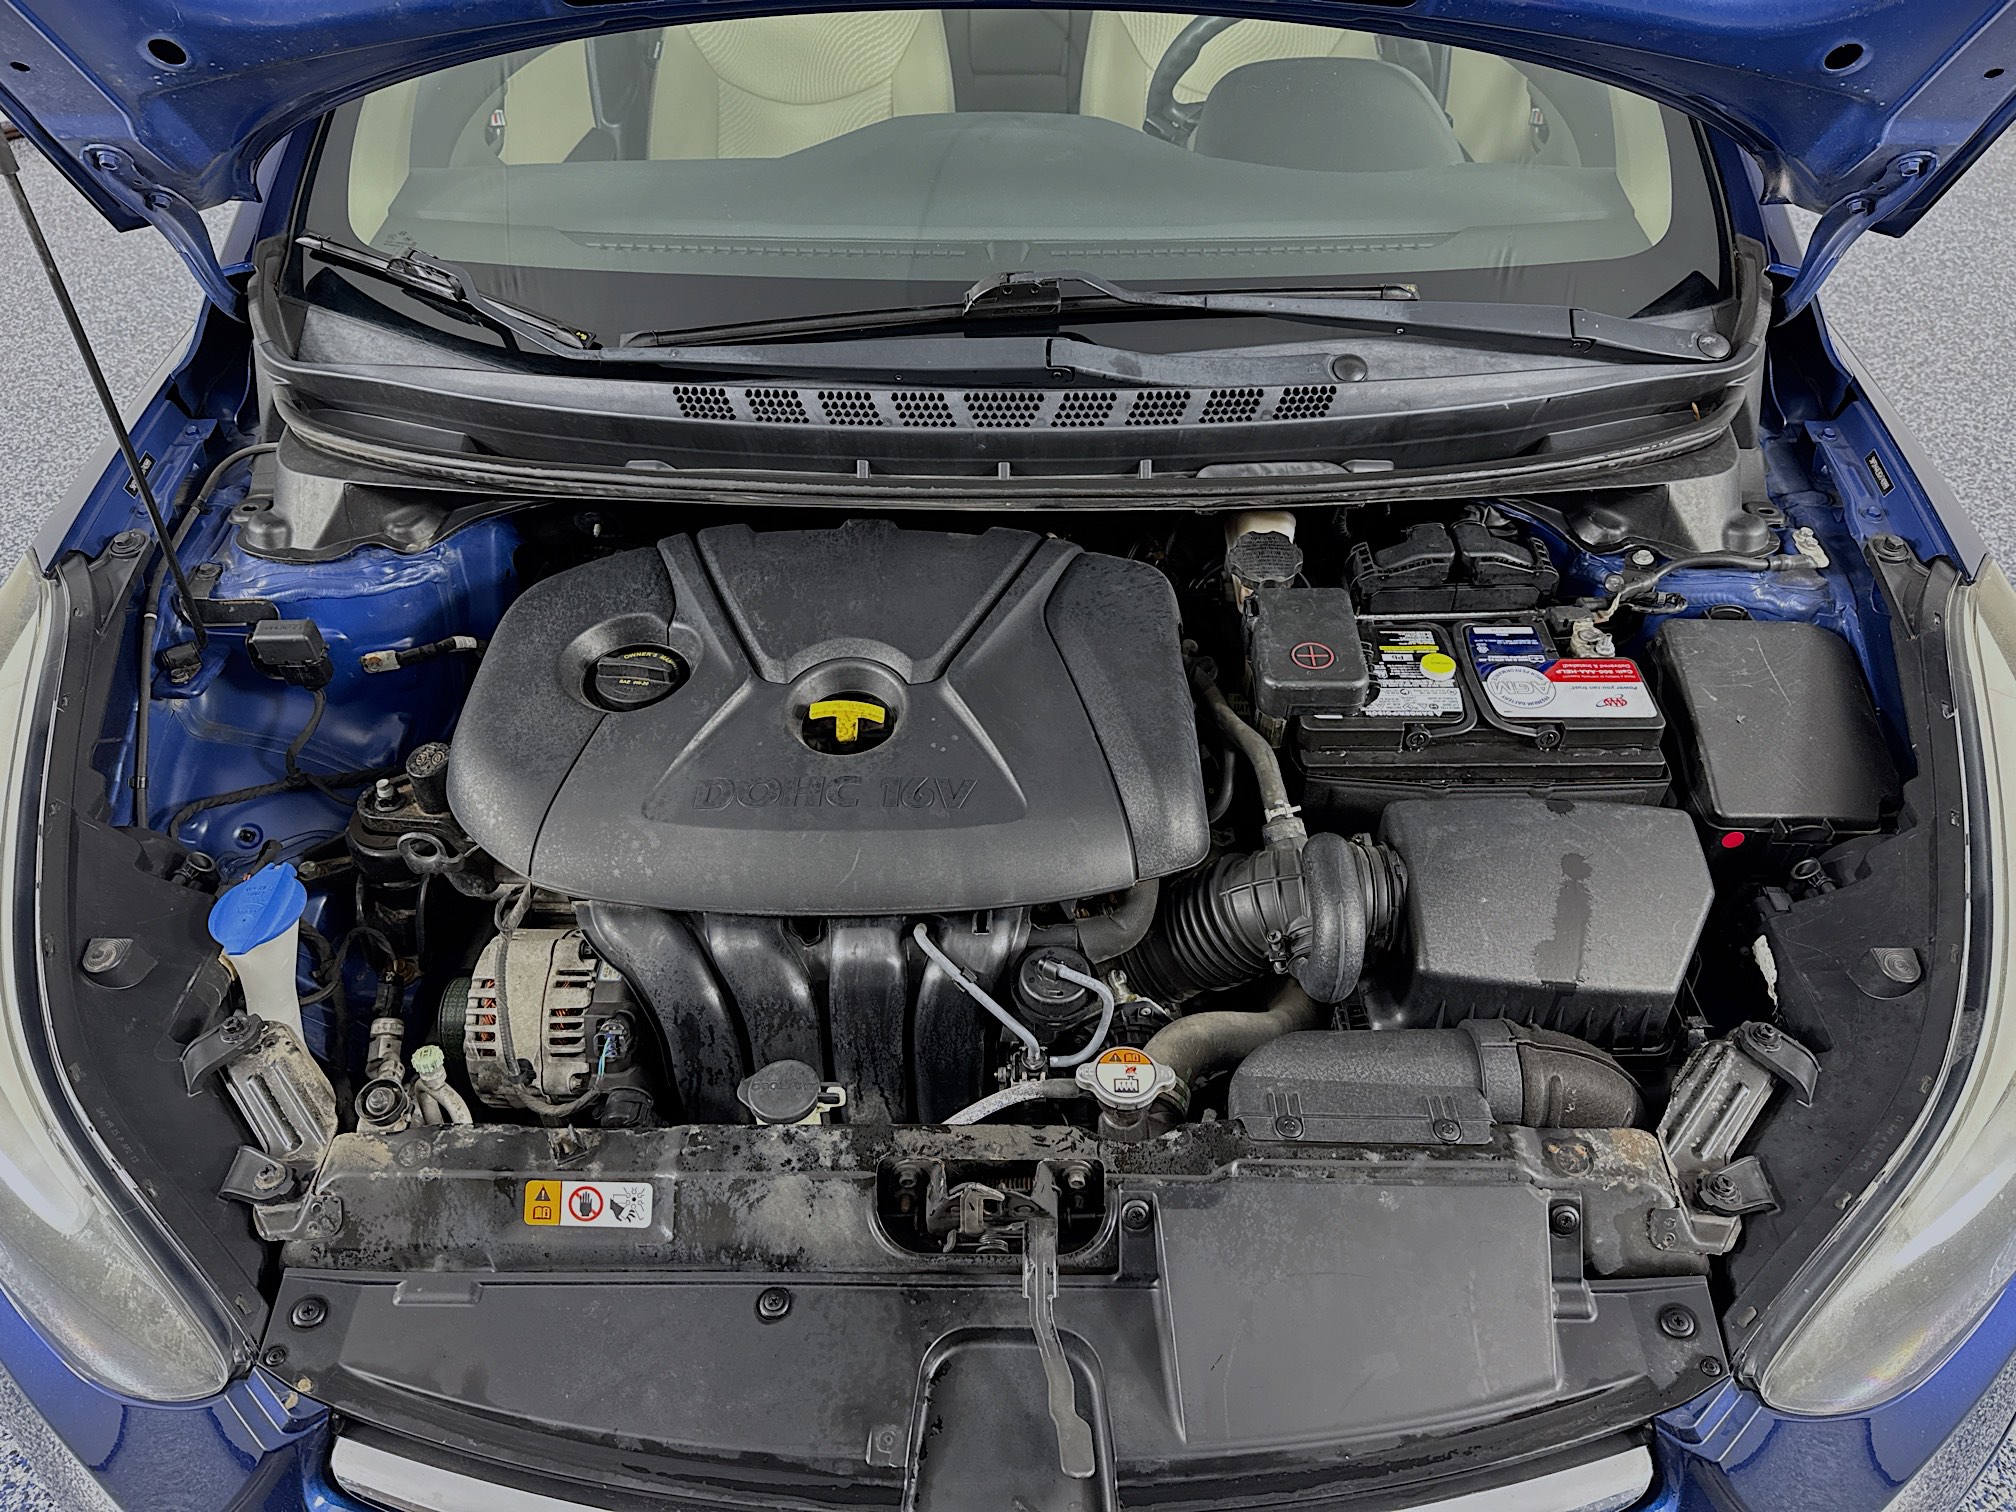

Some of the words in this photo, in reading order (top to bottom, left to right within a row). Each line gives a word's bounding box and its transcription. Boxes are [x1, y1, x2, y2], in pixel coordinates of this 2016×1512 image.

[623, 652, 658, 660] OWNER'S
[1489, 681, 1550, 695] AGM
[1501, 695, 1526, 706] BATTERY
[1526, 695, 1550, 706] PREMIUM
[693, 775, 863, 810] DOHC
[879, 776, 979, 810] 16V
[420, 1049, 431, 1057] H
[1078, 1068, 1094, 1076] HCC
[750, 1081, 818, 1091] COOLANT
